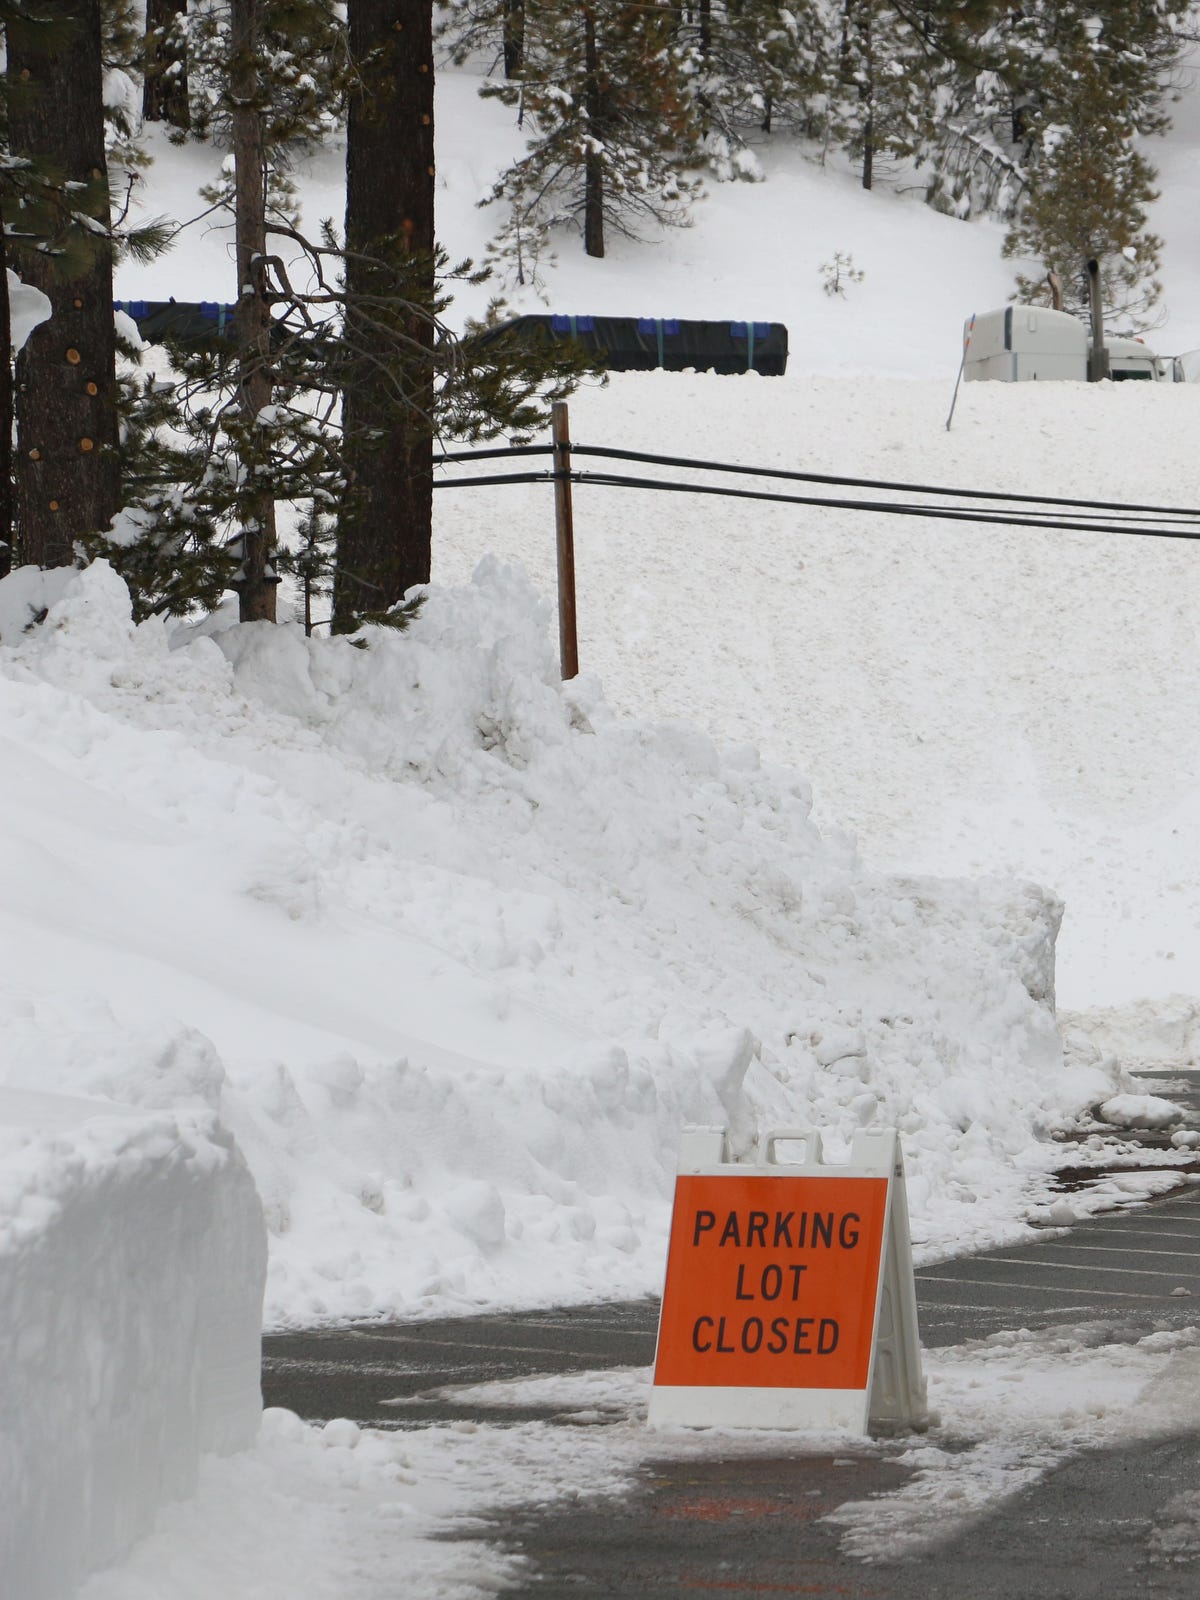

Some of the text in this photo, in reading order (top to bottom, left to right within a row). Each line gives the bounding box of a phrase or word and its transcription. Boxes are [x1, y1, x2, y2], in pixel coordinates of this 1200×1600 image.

[693, 1210, 860, 1249] PARKING
[736, 1264, 807, 1301] LOT
[692, 1316, 840, 1355] CLOSED
